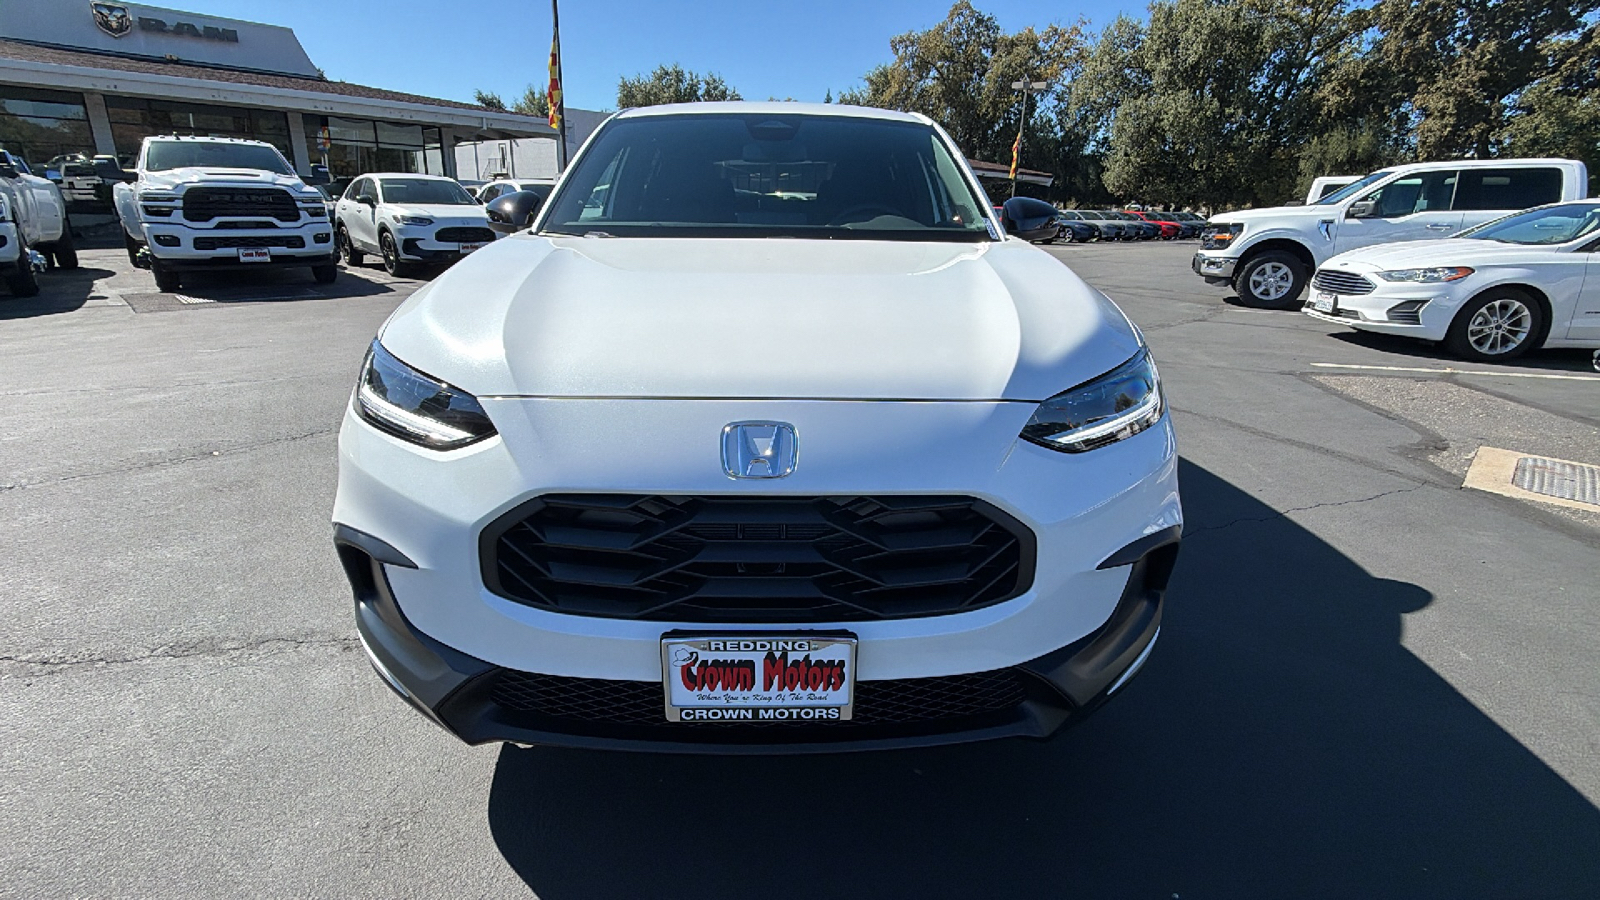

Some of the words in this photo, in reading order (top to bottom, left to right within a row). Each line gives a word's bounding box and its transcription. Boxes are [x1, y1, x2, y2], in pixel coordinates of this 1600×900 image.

[138, 16, 239, 43] RAM
[710, 641, 809, 651] REDDING
[681, 651, 756, 692] Crown
[763, 651, 846, 692] Motors
[696, 693, 721, 701] Where
[722, 693, 750, 704] You're
[752, 693, 773, 702] King
[775, 693, 786, 703] Of
[788, 692, 803, 701] The
[806, 692, 829, 701] Road
[681, 708, 754, 720] CROWN
[759, 708, 840, 720] MOTORS
